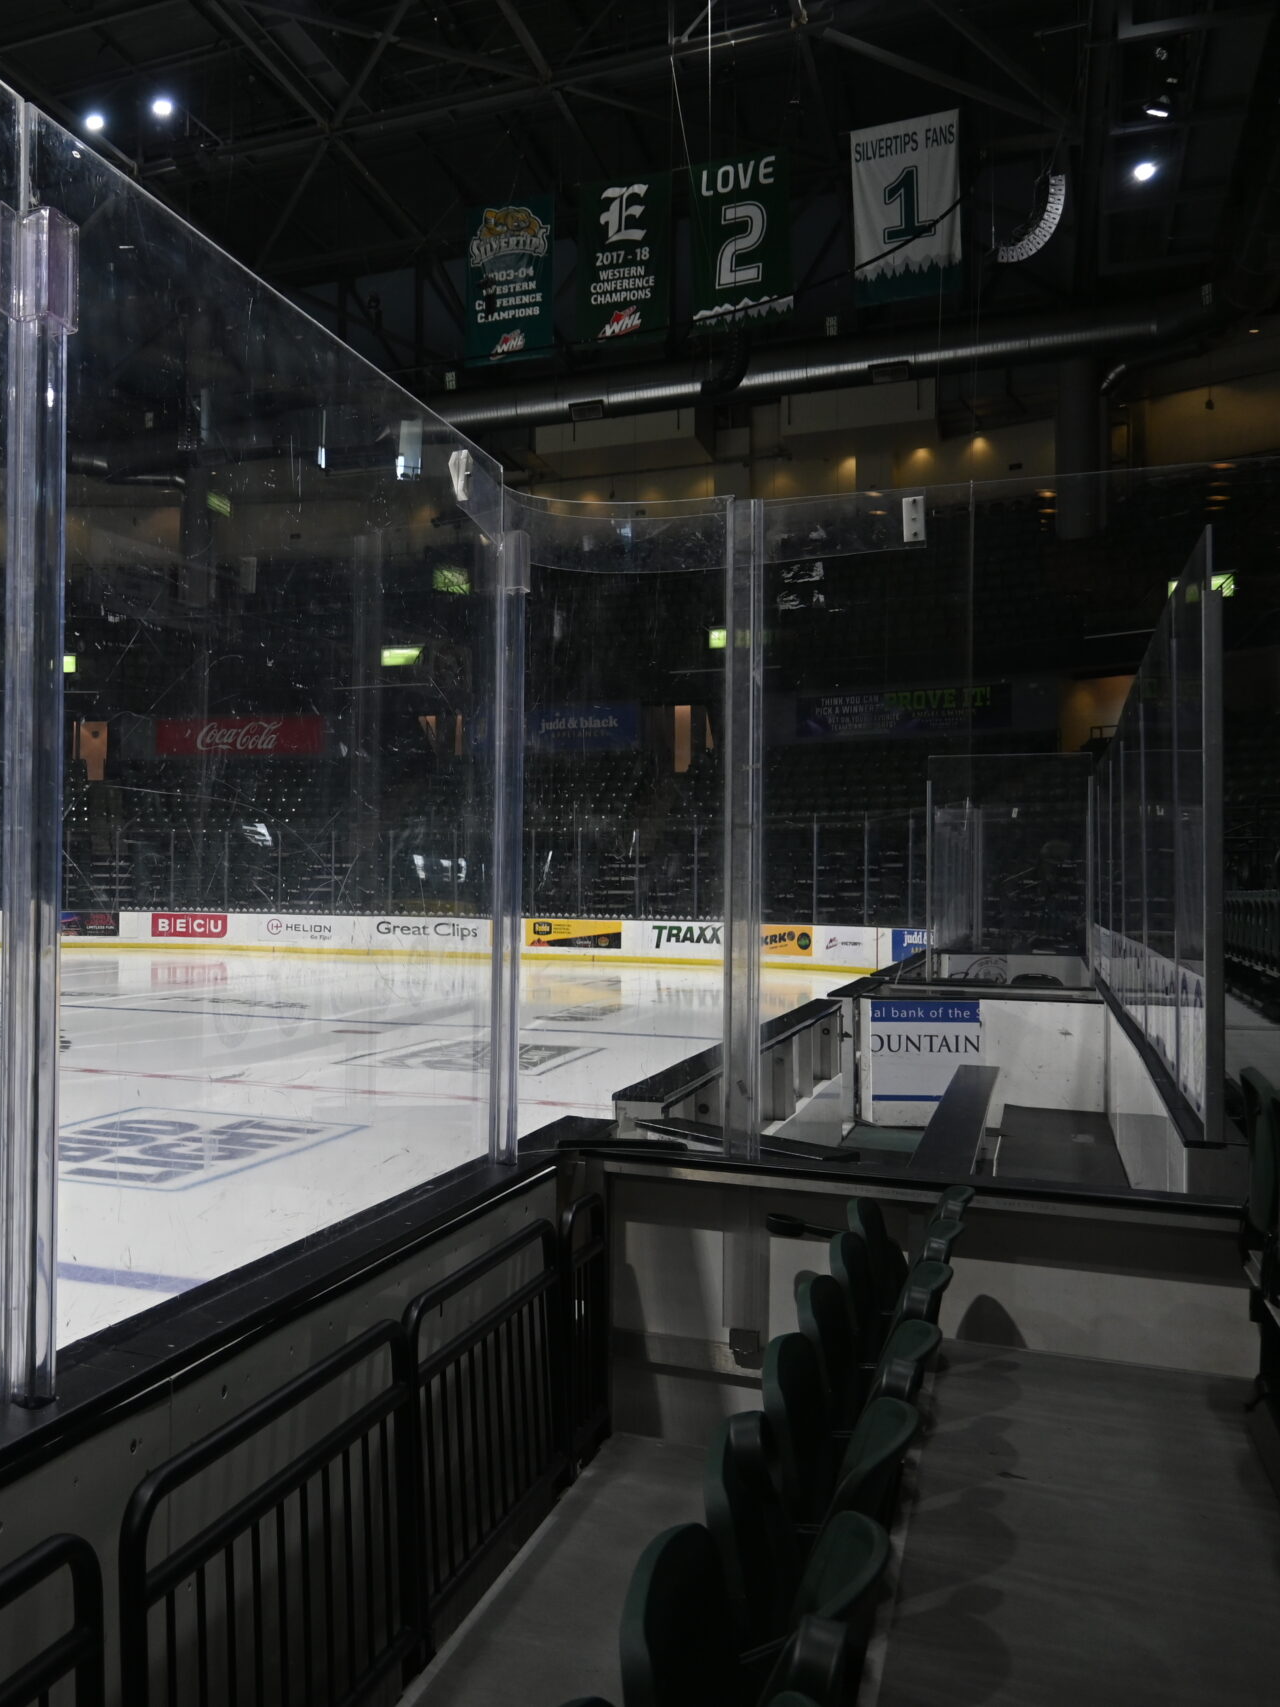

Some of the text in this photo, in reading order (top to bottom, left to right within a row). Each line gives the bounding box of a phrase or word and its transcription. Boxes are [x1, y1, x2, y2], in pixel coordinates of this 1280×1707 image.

[854, 124, 956, 164] SILVERTIPS FANS
[700, 155, 776, 197] LOVE
[599, 183, 649, 245] E
[883, 165, 937, 245] 1
[715, 200, 768, 290] 2
[596, 250, 625, 266] 2017
[635, 247, 650, 261] 18
[599, 266, 645, 281] WESTERN
[590, 276, 655, 293] CONFERENCE
[475, 293, 543, 311] CFERENCE
[591, 288, 651, 305] CHAMPIONS
[604, 312, 642, 338] WHL
[539, 712, 618, 734] judd & black
[197, 721, 282, 751] Coca-Cola
[157, 917, 223, 932] BECU
[286, 923, 332, 933] HELION
[376, 921, 478, 941] Great Clips
[652, 924, 722, 948] TRAXX
[903, 931, 922, 946] judd
[891, 1007, 925, 1018] bank
[929, 1007, 944, 1018] of
[948, 1008, 971, 1018] the
